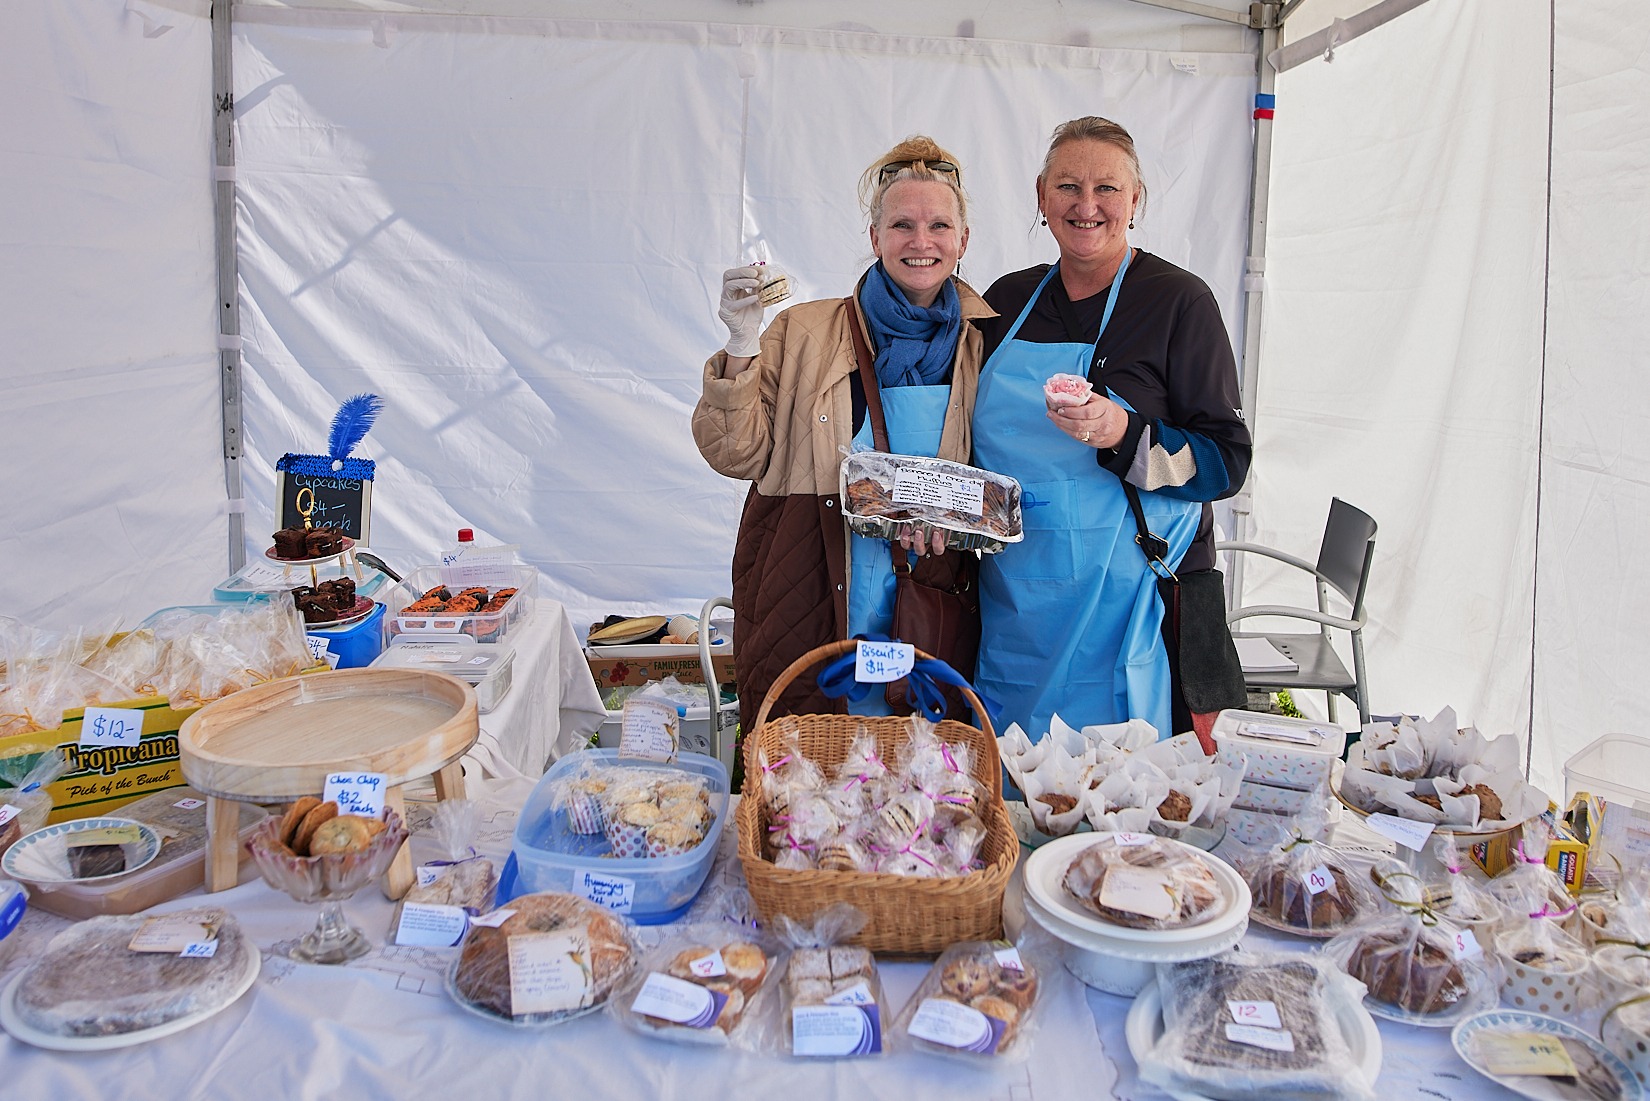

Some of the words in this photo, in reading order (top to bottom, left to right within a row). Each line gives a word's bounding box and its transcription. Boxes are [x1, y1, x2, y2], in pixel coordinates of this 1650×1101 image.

[295, 473, 360, 496] Cupcakes
[917, 476, 953, 487] Muffins
[861, 644, 905, 660] Biscuits
[653, 660, 678, 671] FAMILY
[679, 659, 701, 670] FRESH
[60, 737, 179, 774] Tropicana
[100, 781, 113, 795] of
[115, 777, 133, 790] the
[337, 789, 362, 806] $2
[1567, 853, 1577, 882] GOLIATH
[1310, 873, 1325, 887] 8
[1238, 1005, 1262, 1019] 12
